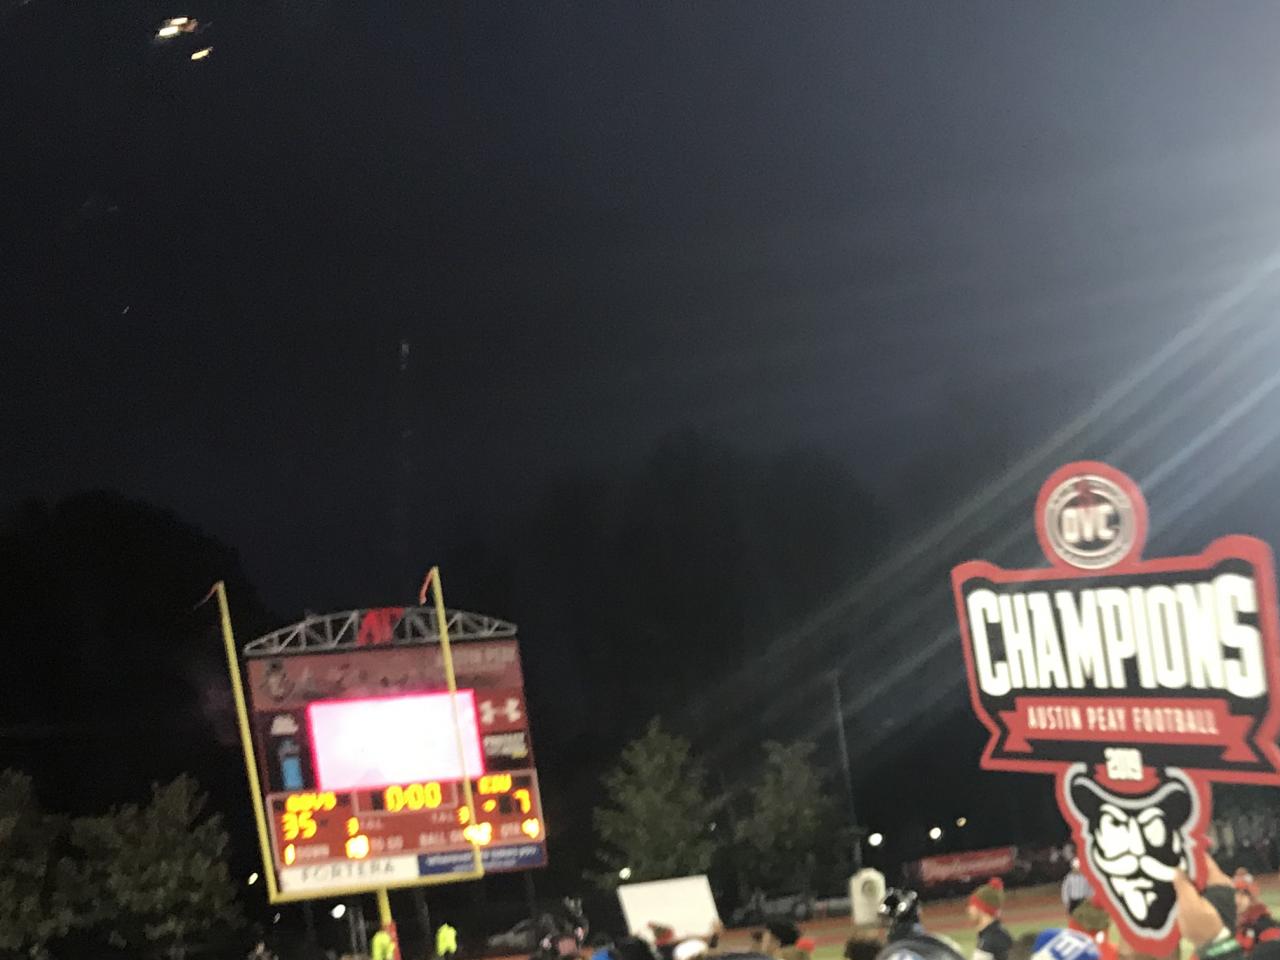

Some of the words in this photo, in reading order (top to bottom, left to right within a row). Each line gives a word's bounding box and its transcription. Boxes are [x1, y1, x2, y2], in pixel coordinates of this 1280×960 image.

[966, 572, 1268, 698] CHAMPIONS
[1027, 706, 1083, 731] AUSTIN
[1087, 706, 1128, 732] PEAY
[1132, 707, 1219, 736] FOOTBALL
